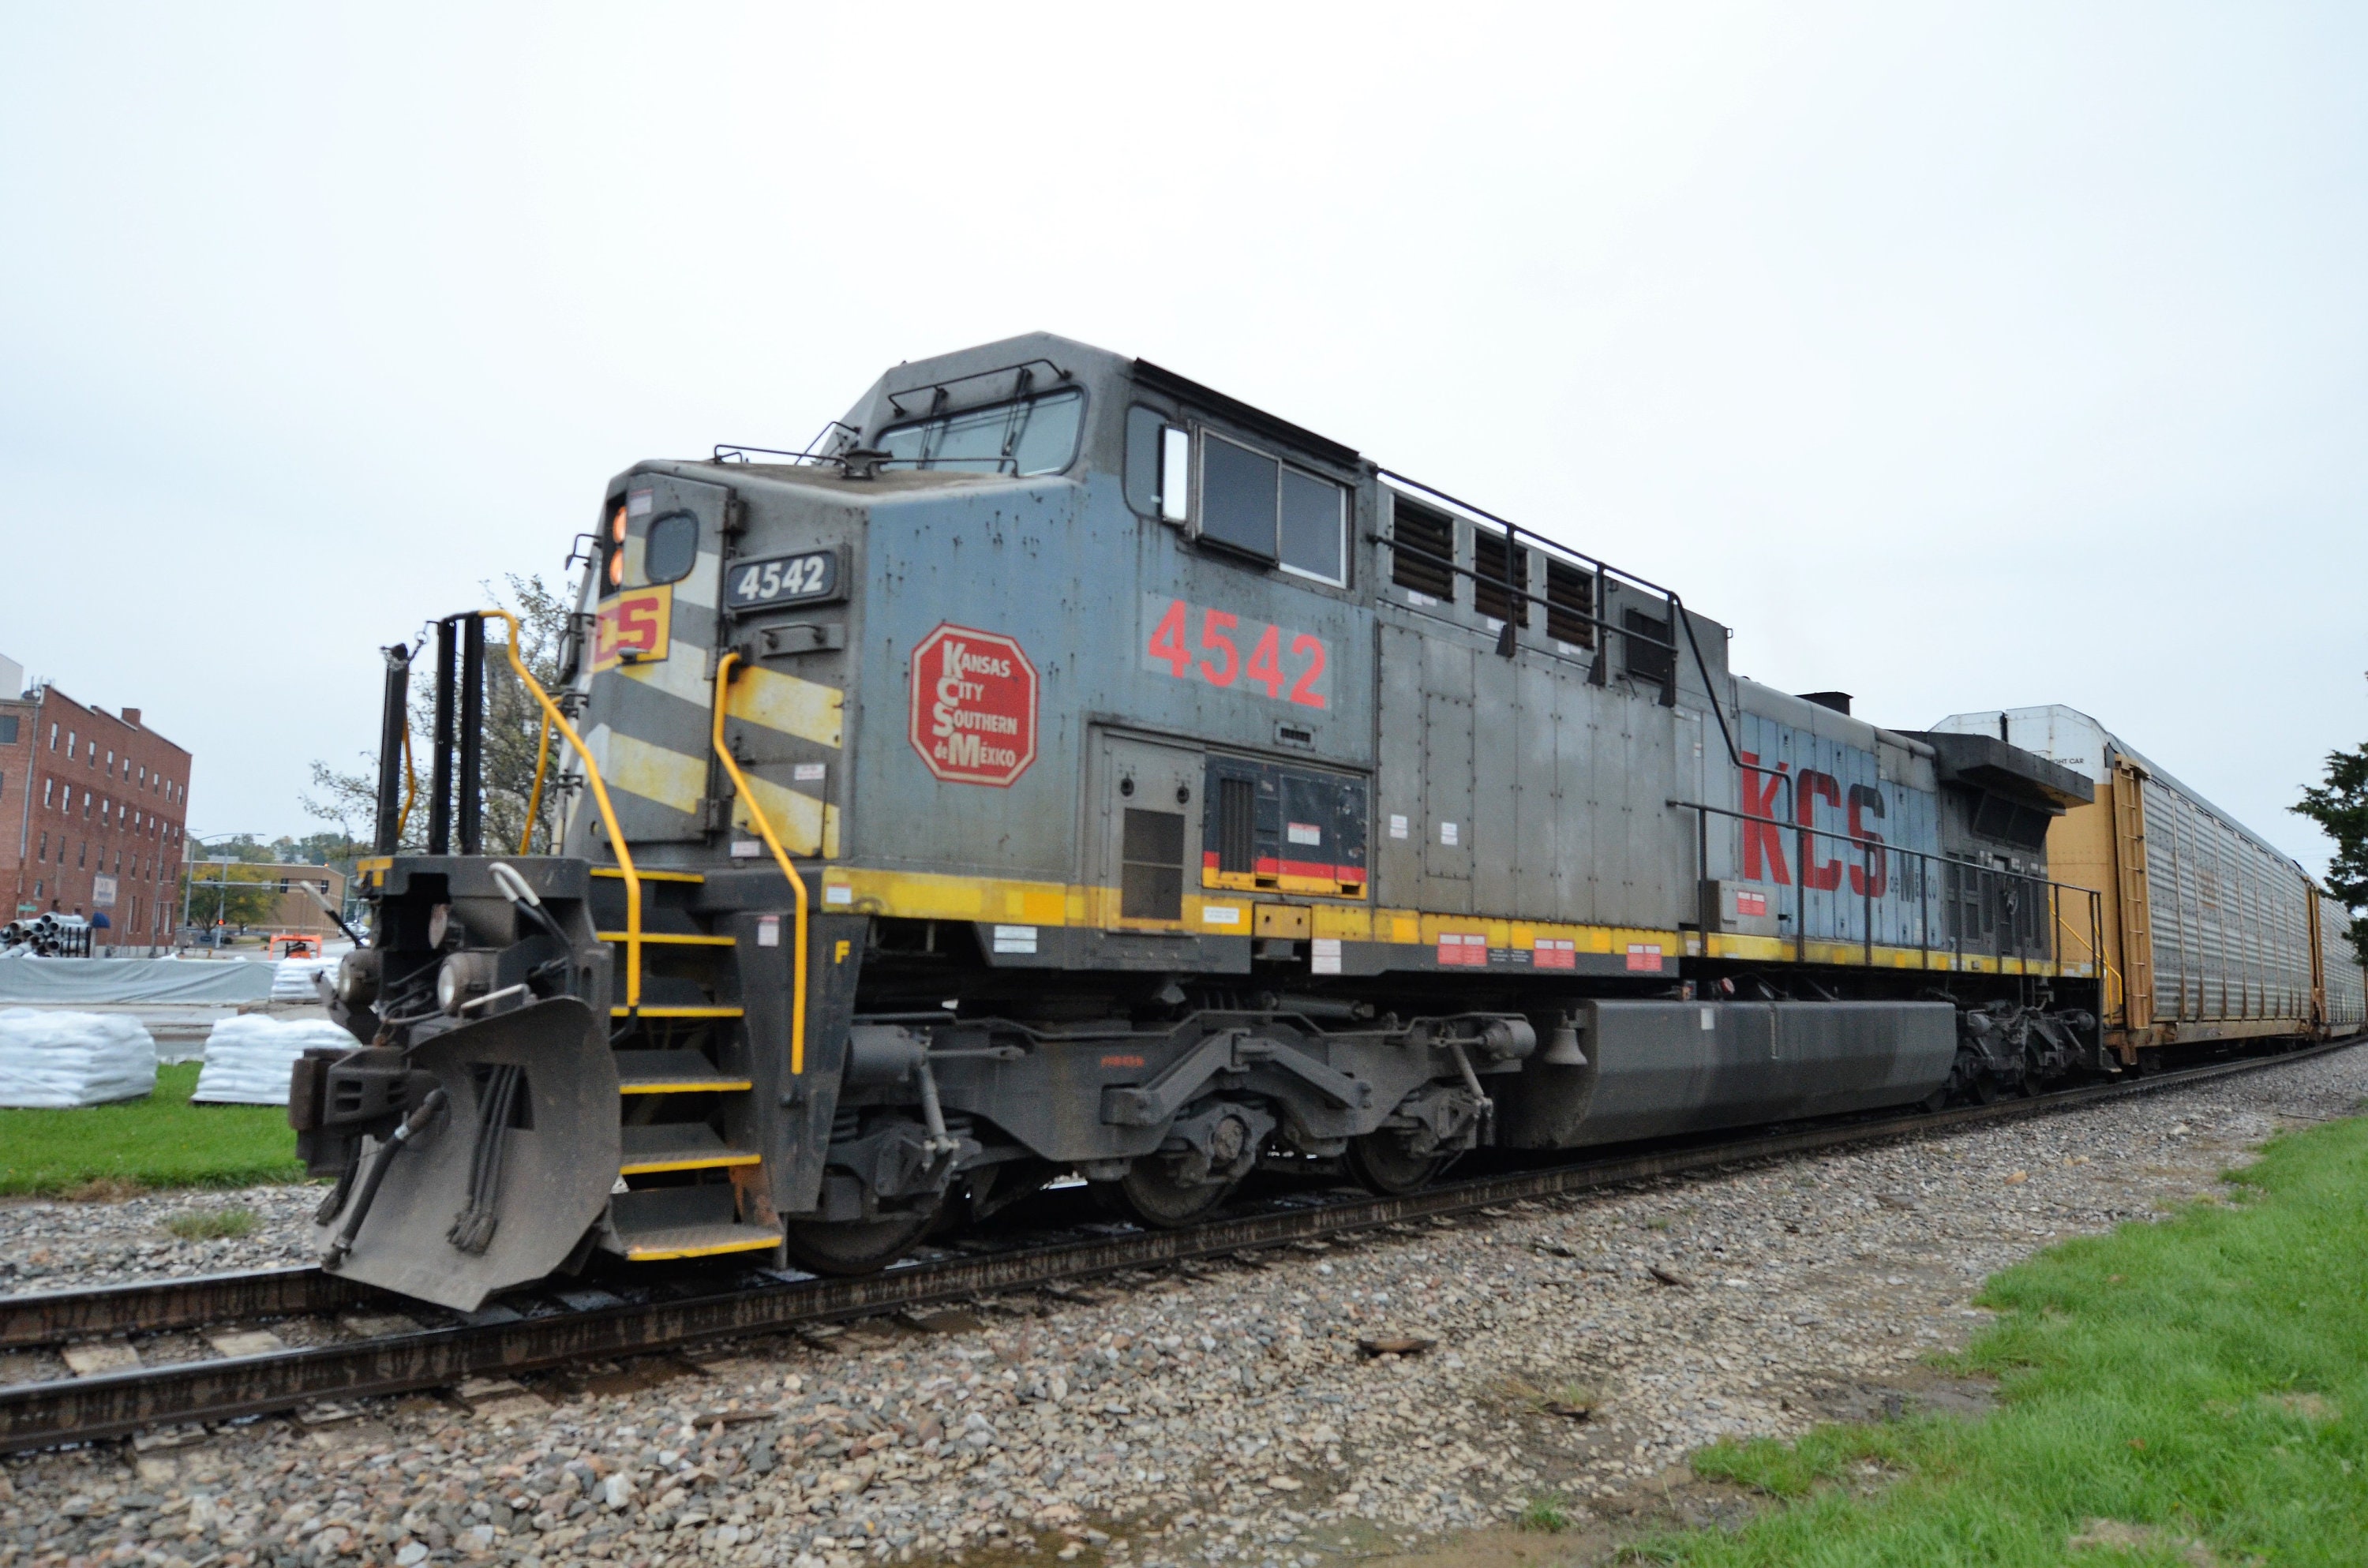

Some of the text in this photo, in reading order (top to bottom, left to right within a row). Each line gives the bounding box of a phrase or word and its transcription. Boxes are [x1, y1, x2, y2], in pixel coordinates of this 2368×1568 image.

[737, 556, 824, 601] 4542
[1148, 599, 1326, 709] 4542
[1742, 750, 1887, 898] KCS
[834, 940, 850, 964] F
